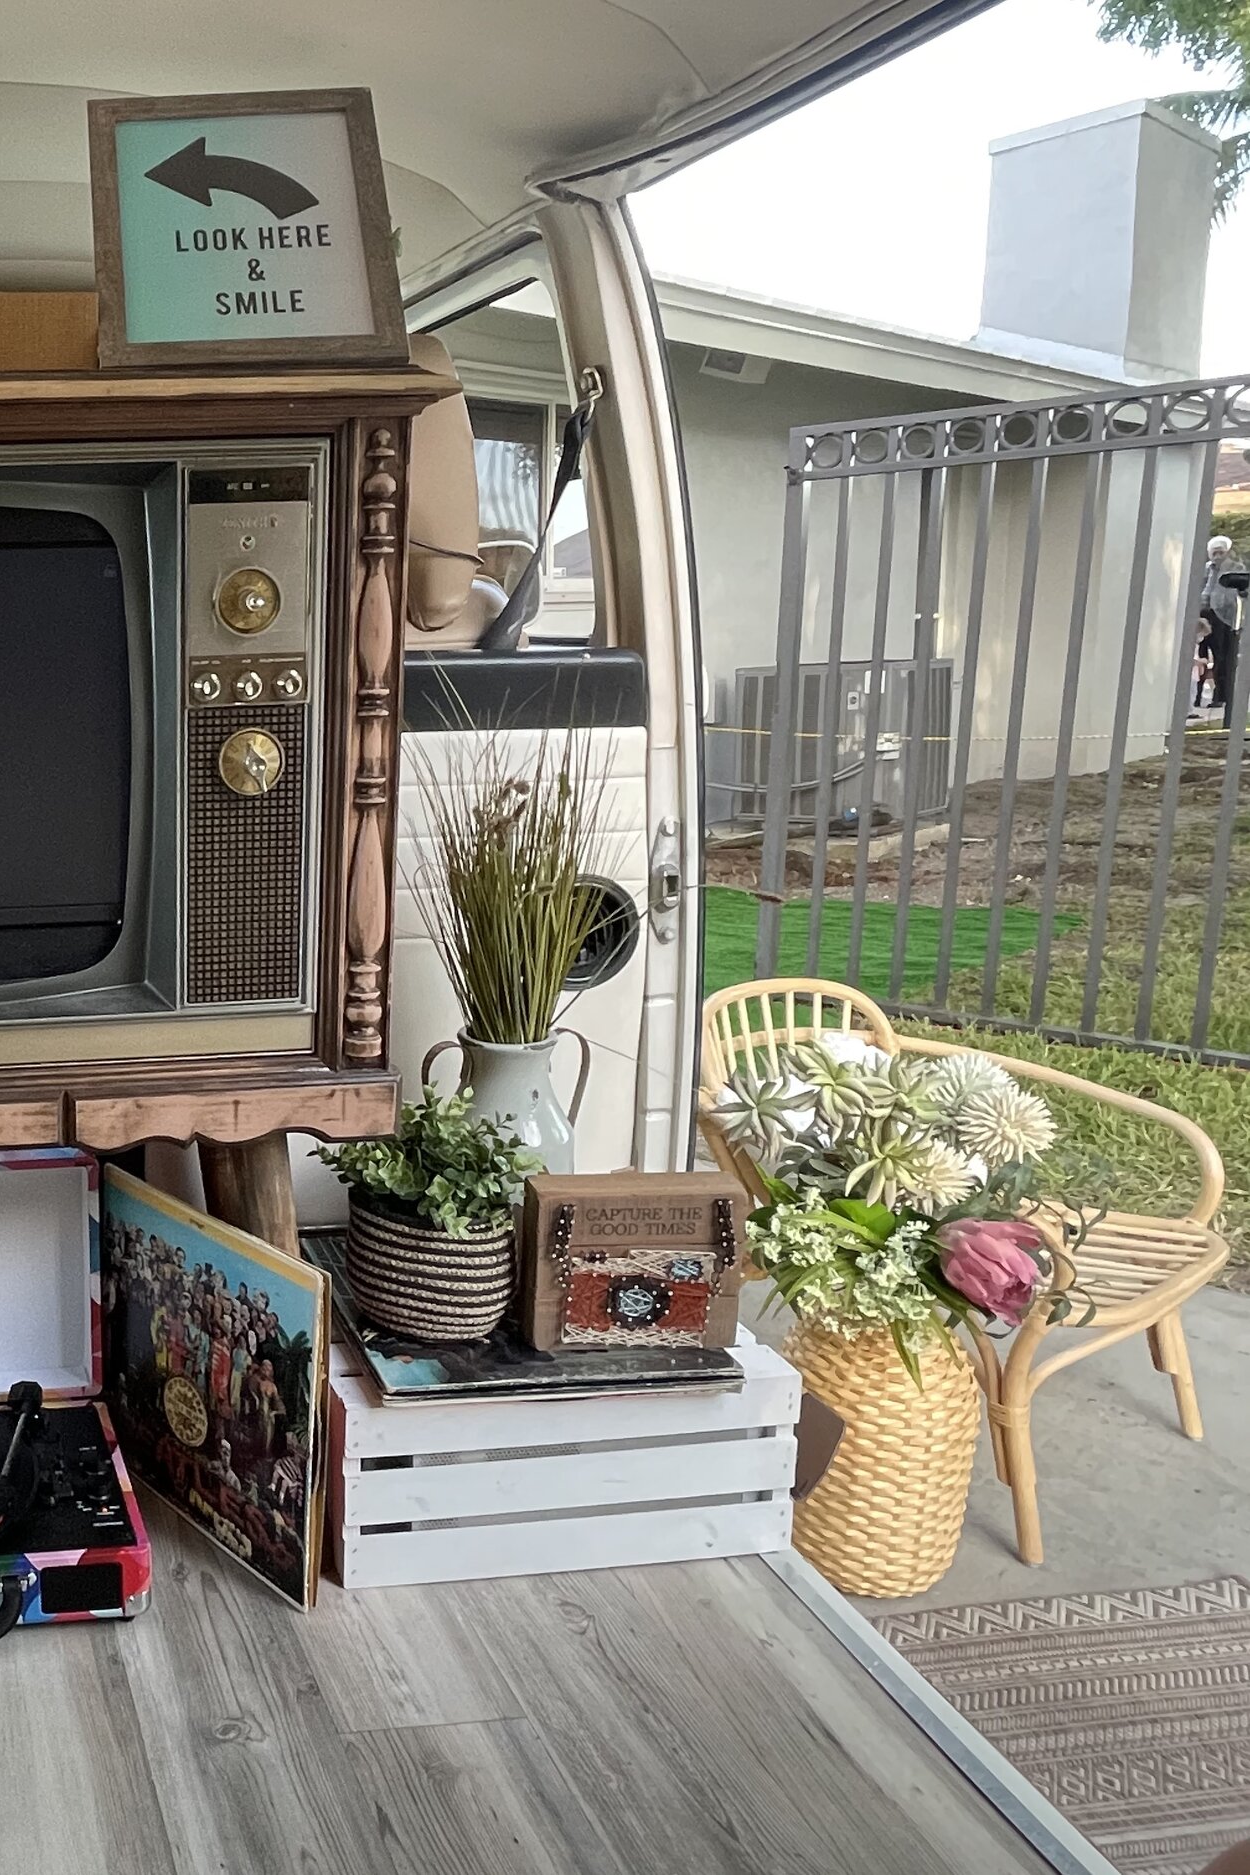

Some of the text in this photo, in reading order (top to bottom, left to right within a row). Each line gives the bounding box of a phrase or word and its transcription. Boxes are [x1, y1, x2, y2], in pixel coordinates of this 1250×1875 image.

[174, 224, 332, 252] LOOK HERE
[247, 258, 266, 282] &
[215, 289, 306, 316] SMILE
[585, 1206, 704, 1221] CAPTURE THE
[589, 1221, 697, 1236] GOOD TIMES
